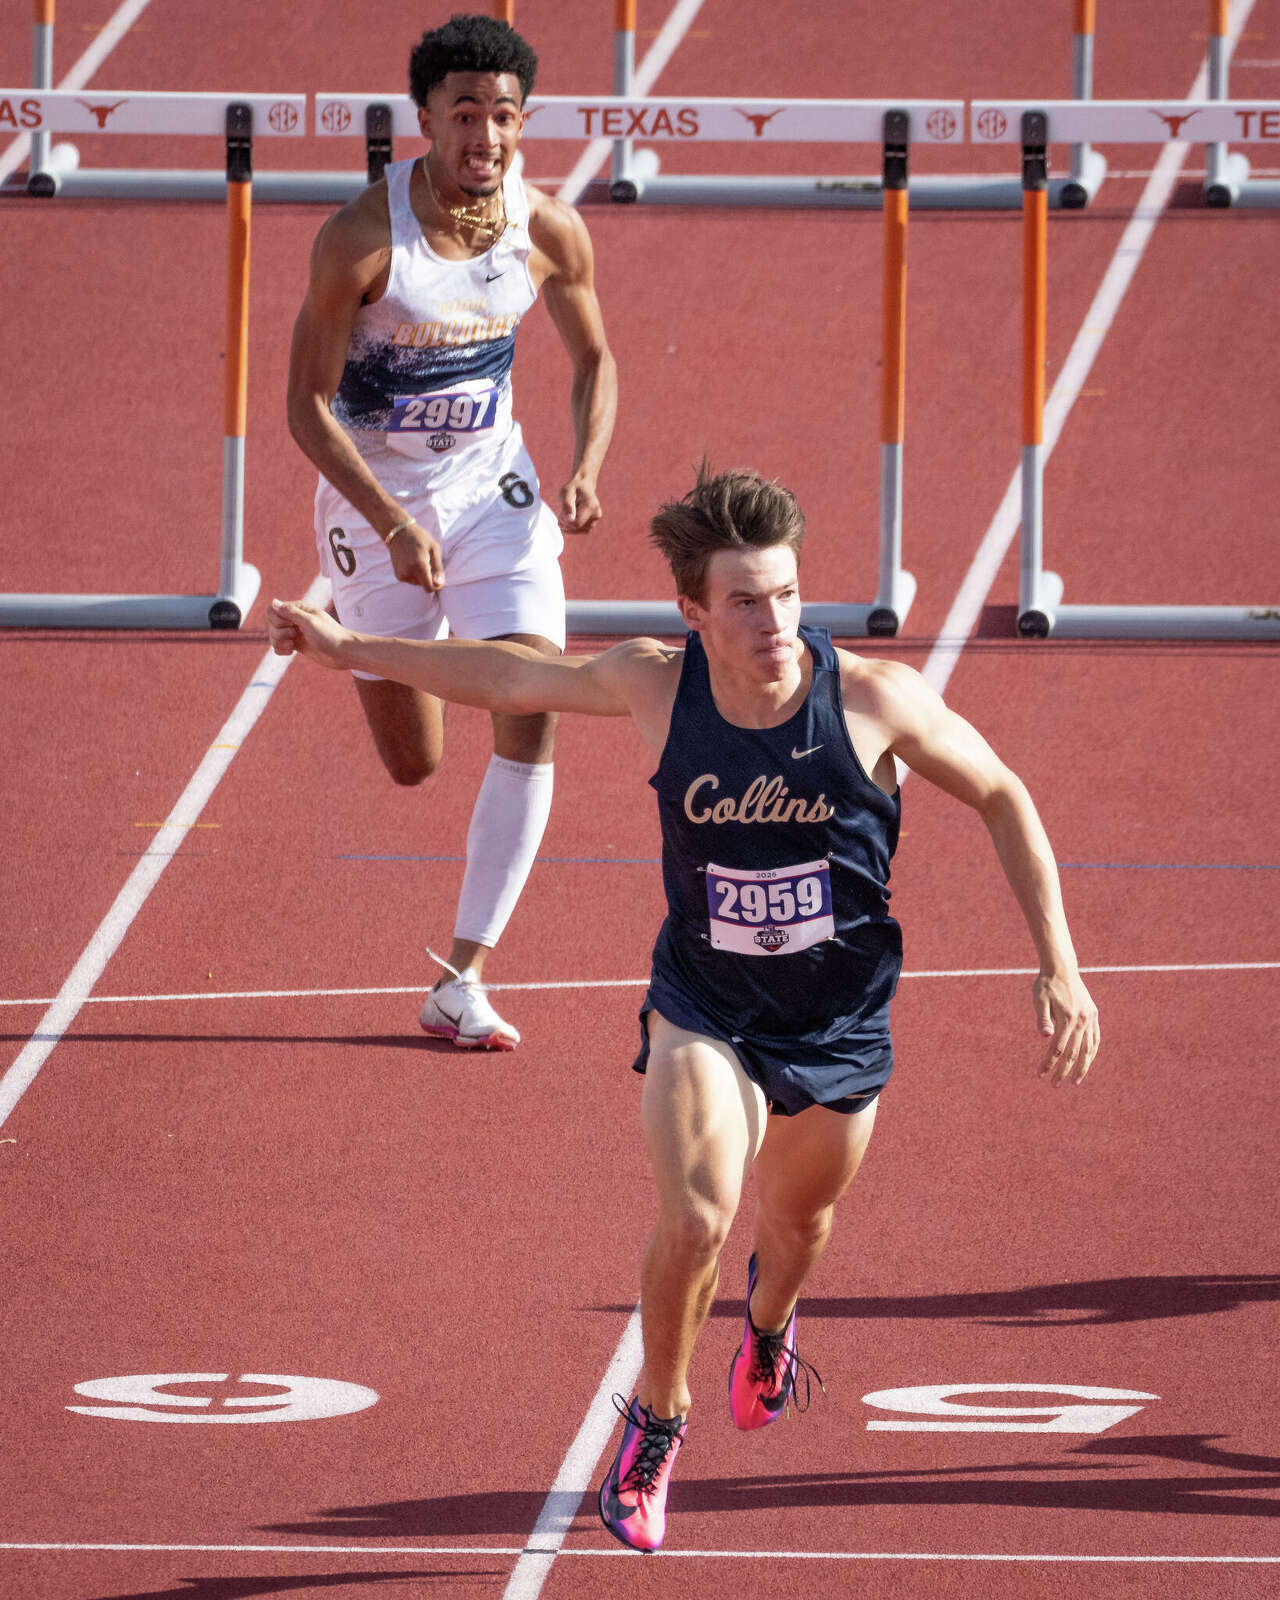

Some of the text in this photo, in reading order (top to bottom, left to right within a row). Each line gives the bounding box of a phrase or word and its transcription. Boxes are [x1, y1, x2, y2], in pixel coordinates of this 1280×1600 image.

[577, 107, 699, 137] TEXAS
[400, 394, 490, 428] 2997
[498, 471, 535, 510] 6
[329, 527, 357, 578] 6
[684, 773, 835, 825] Collins
[715, 876, 823, 923] 2959
[754, 934, 789, 945] STATE
[861, 1383, 1161, 1434] 5
